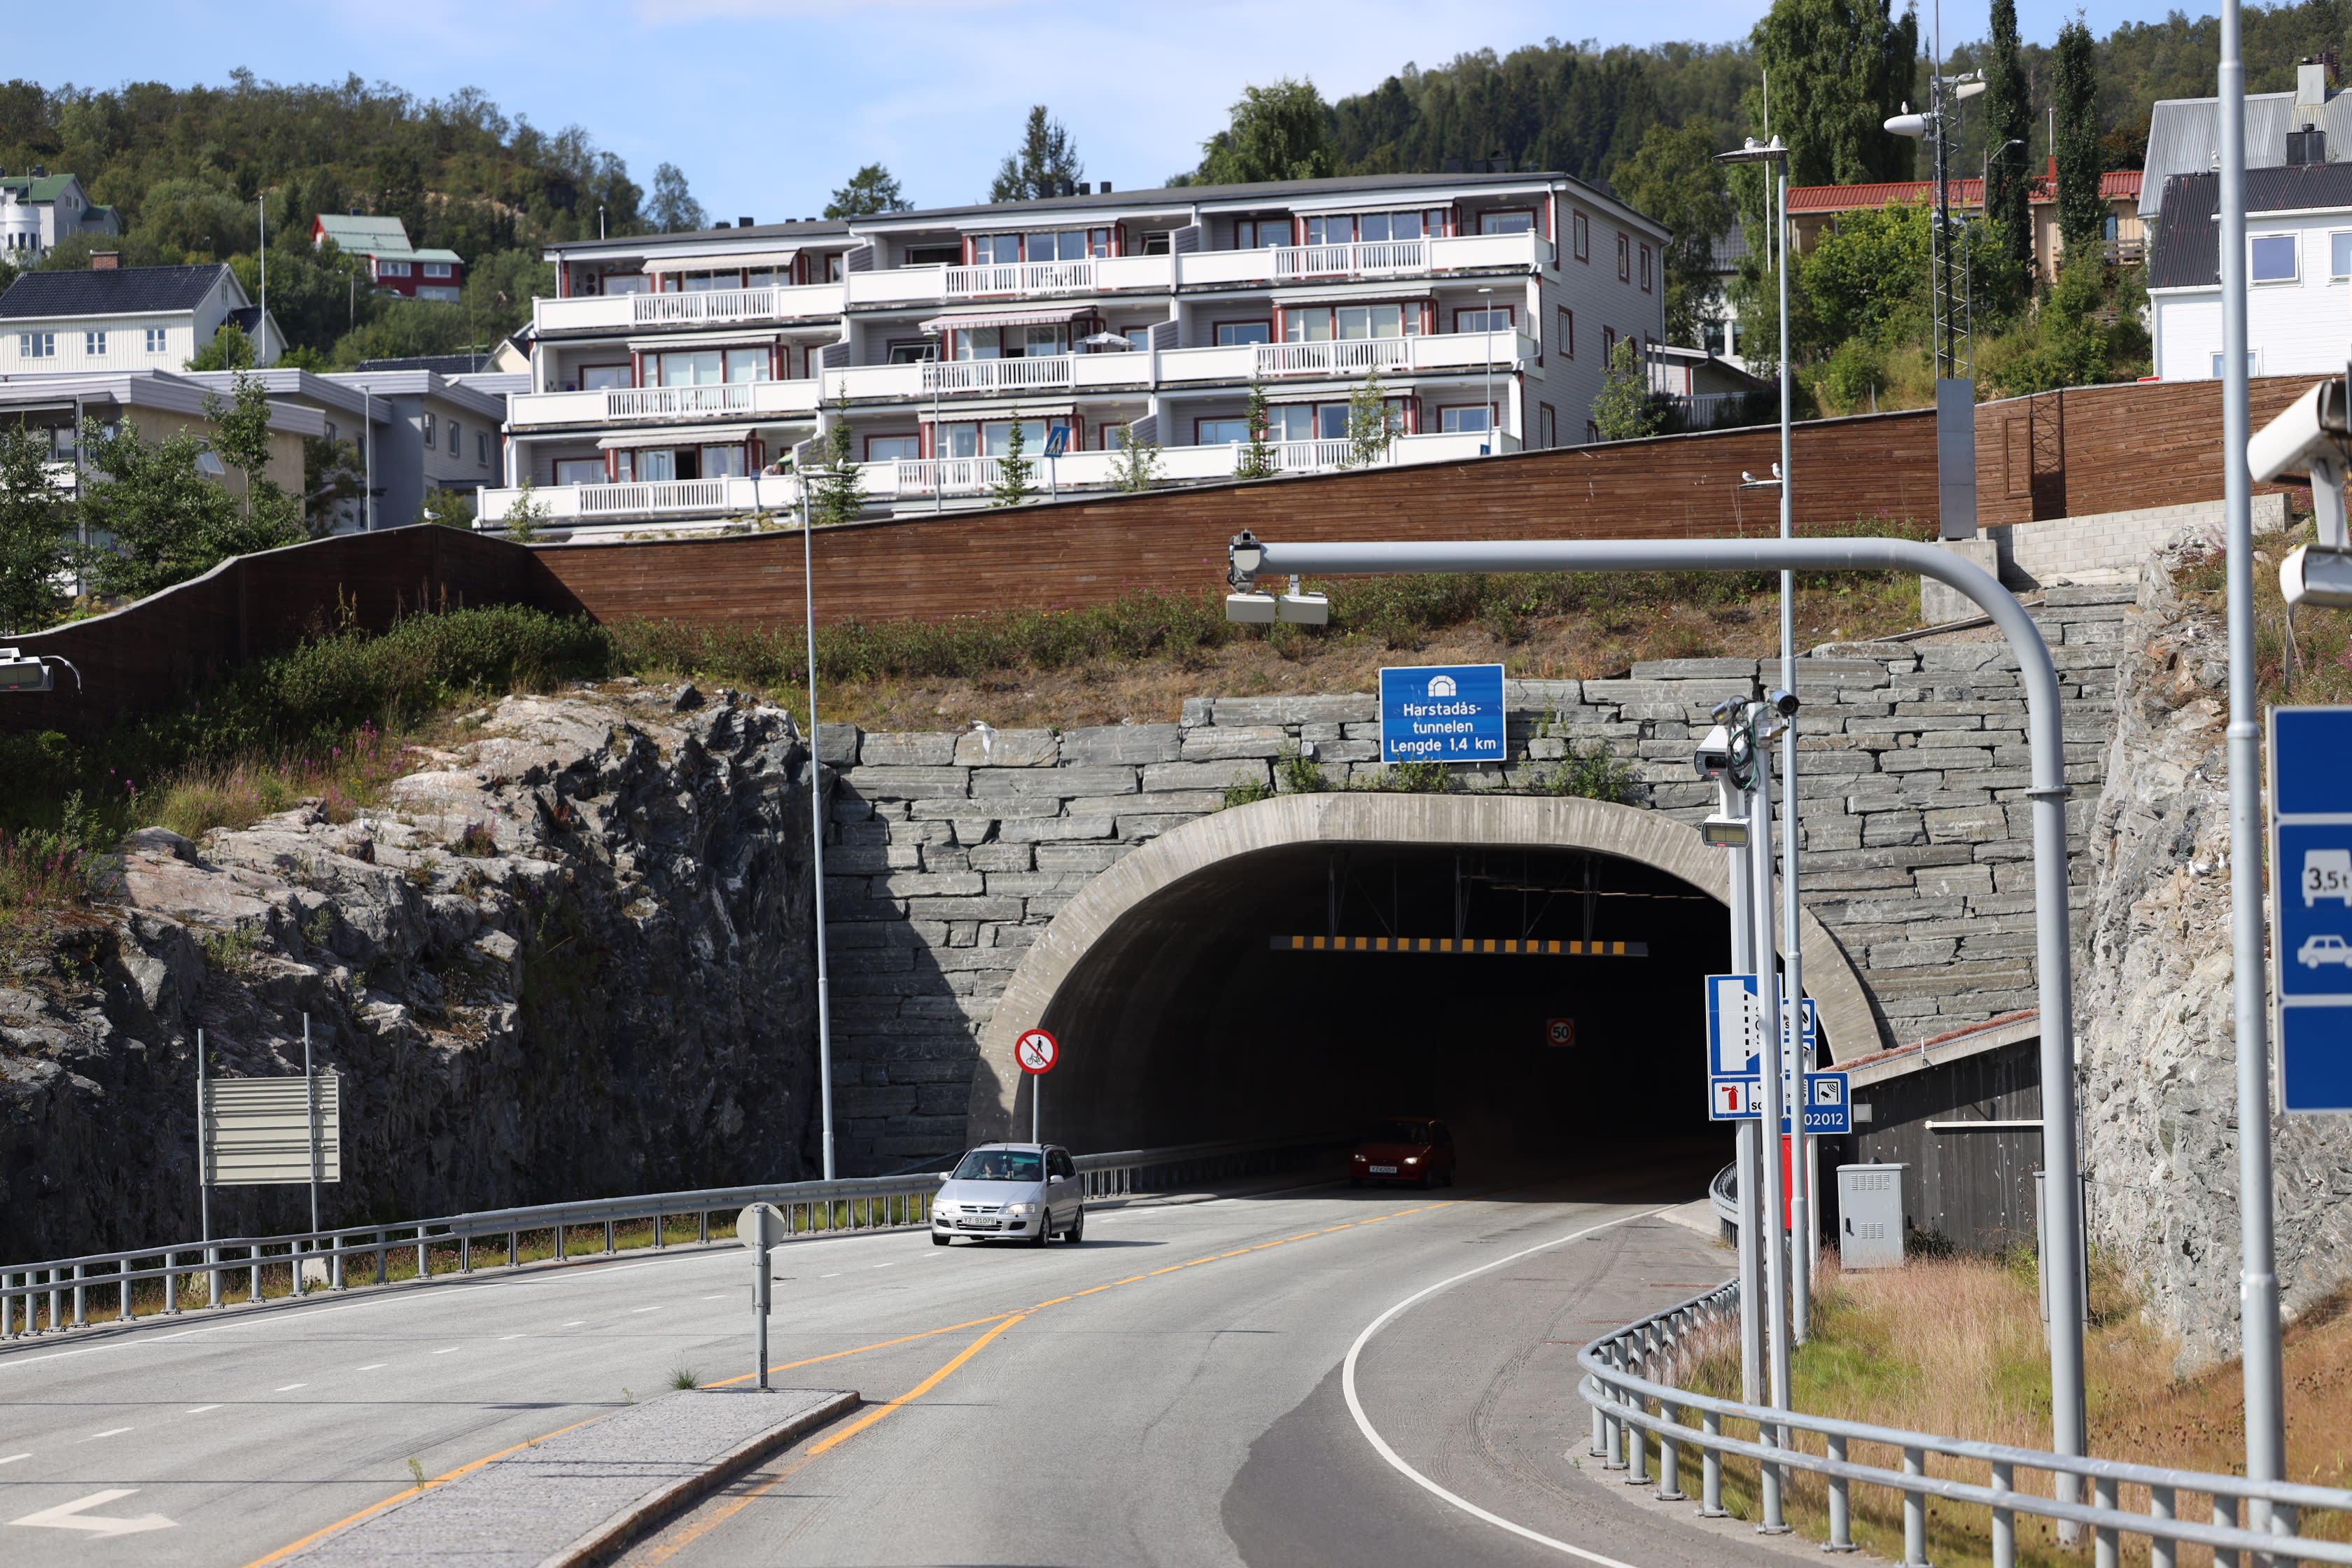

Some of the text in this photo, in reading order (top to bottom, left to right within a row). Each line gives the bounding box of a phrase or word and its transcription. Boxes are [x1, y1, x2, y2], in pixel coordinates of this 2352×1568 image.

[1404, 701, 1481, 716] Harstadås-
[1413, 720, 1473, 734] tunnelen
[1391, 737, 1496, 755] Lengde 1,4 km
[2309, 868, 2348, 892] 3,5 t
[1553, 1026, 1569, 1039] 50
